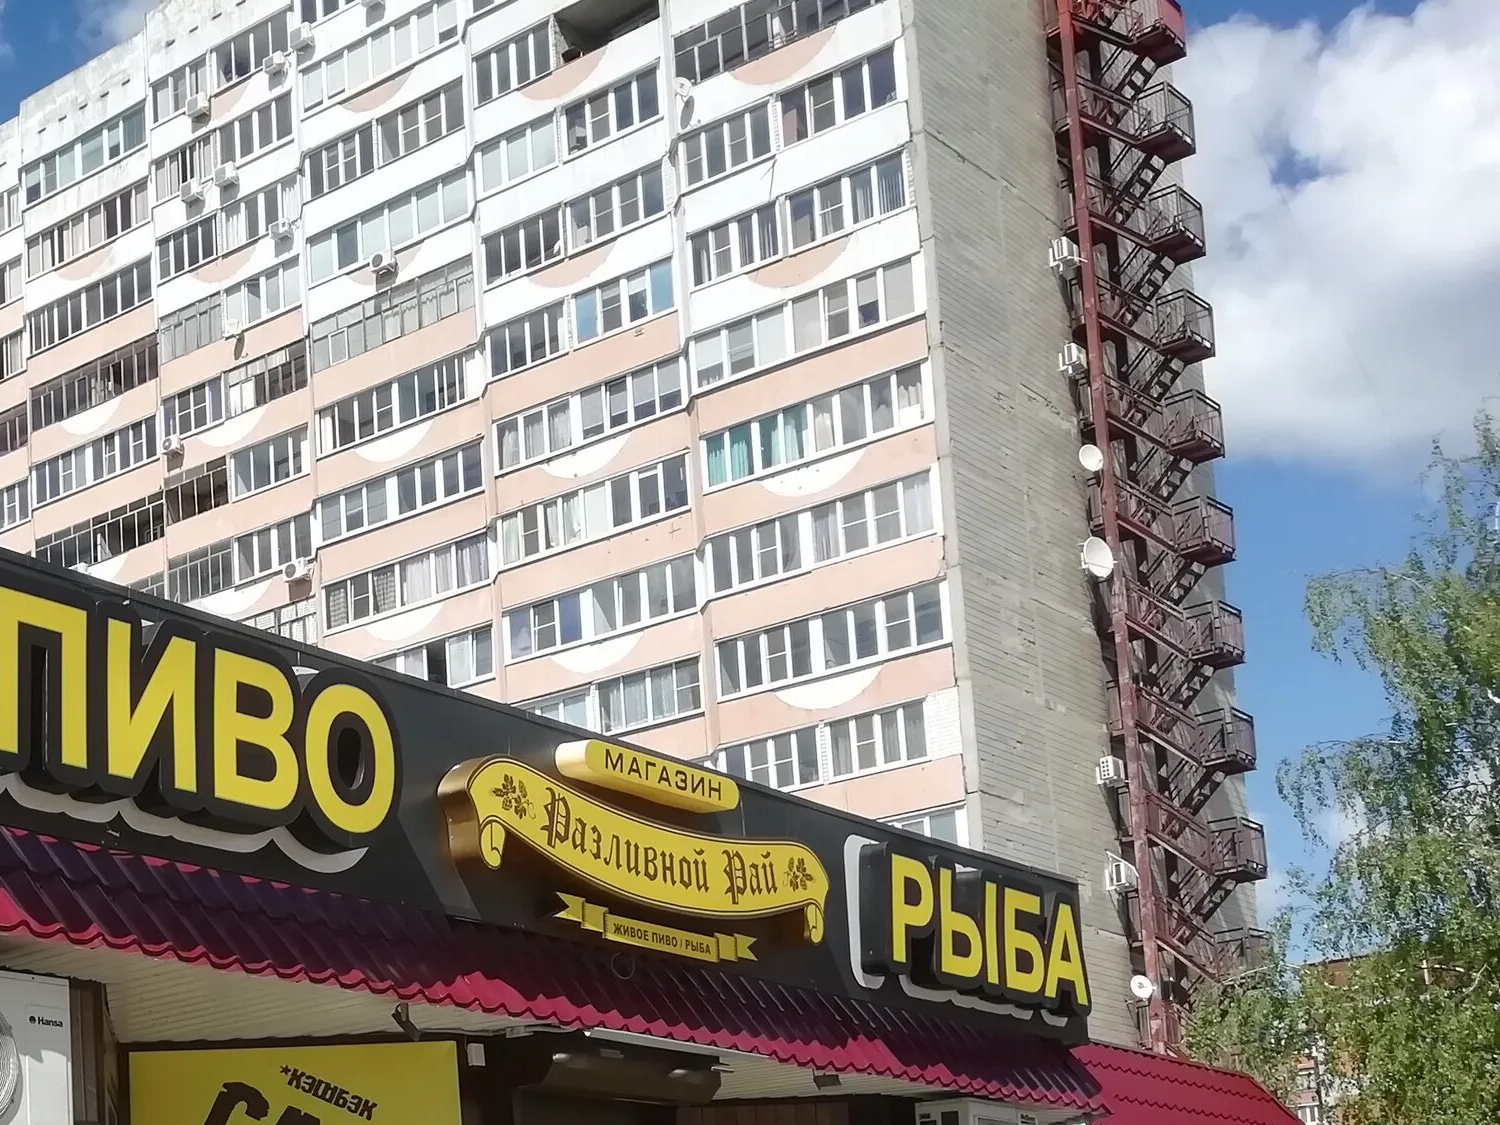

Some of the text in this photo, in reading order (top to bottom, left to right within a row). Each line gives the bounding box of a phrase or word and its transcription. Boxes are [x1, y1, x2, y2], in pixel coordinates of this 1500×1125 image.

[605, 748, 722, 801] МАГАЗИН
[540, 787, 778, 905] Разливной Рай
[613, 923, 649, 942] ЖИВОЕ
[651, 931, 678, 948] ПИВО
[685, 939, 711, 955] РЫБА
[890, 853, 1089, 1007] РЫБА
[37, 1016, 64, 1028] Hansa
